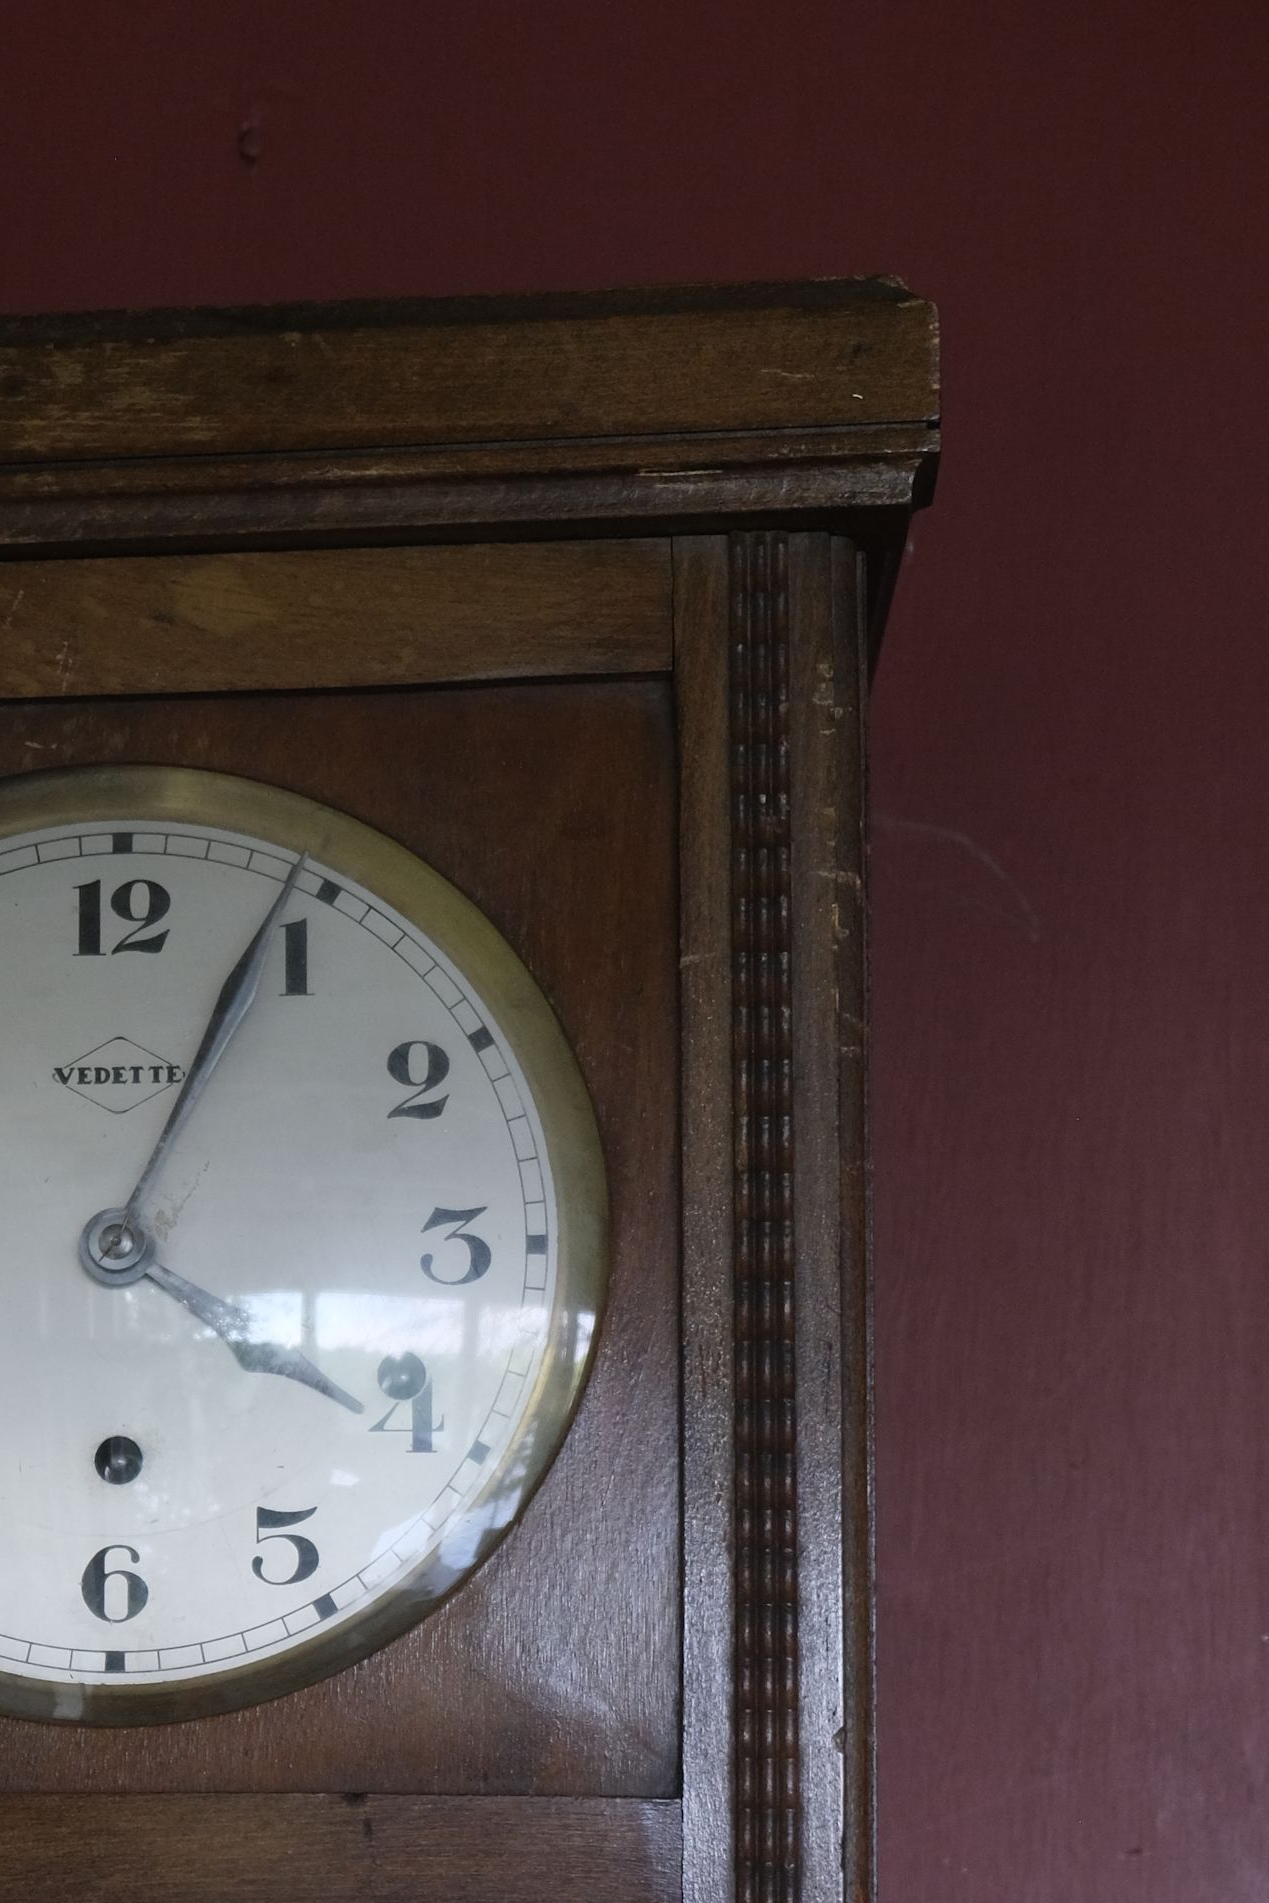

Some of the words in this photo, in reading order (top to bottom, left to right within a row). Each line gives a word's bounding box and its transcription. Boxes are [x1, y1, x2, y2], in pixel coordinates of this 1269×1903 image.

[72, 878, 171, 957] 12
[278, 918, 314, 997] 1
[53, 1065, 182, 1085] VEDETTE
[387, 1040, 450, 1120] 2
[420, 1205, 492, 1286] 3
[368, 1374, 445, 1454] 4
[81, 1544, 149, 1624] 6
[251, 1505, 320, 1585] 5
